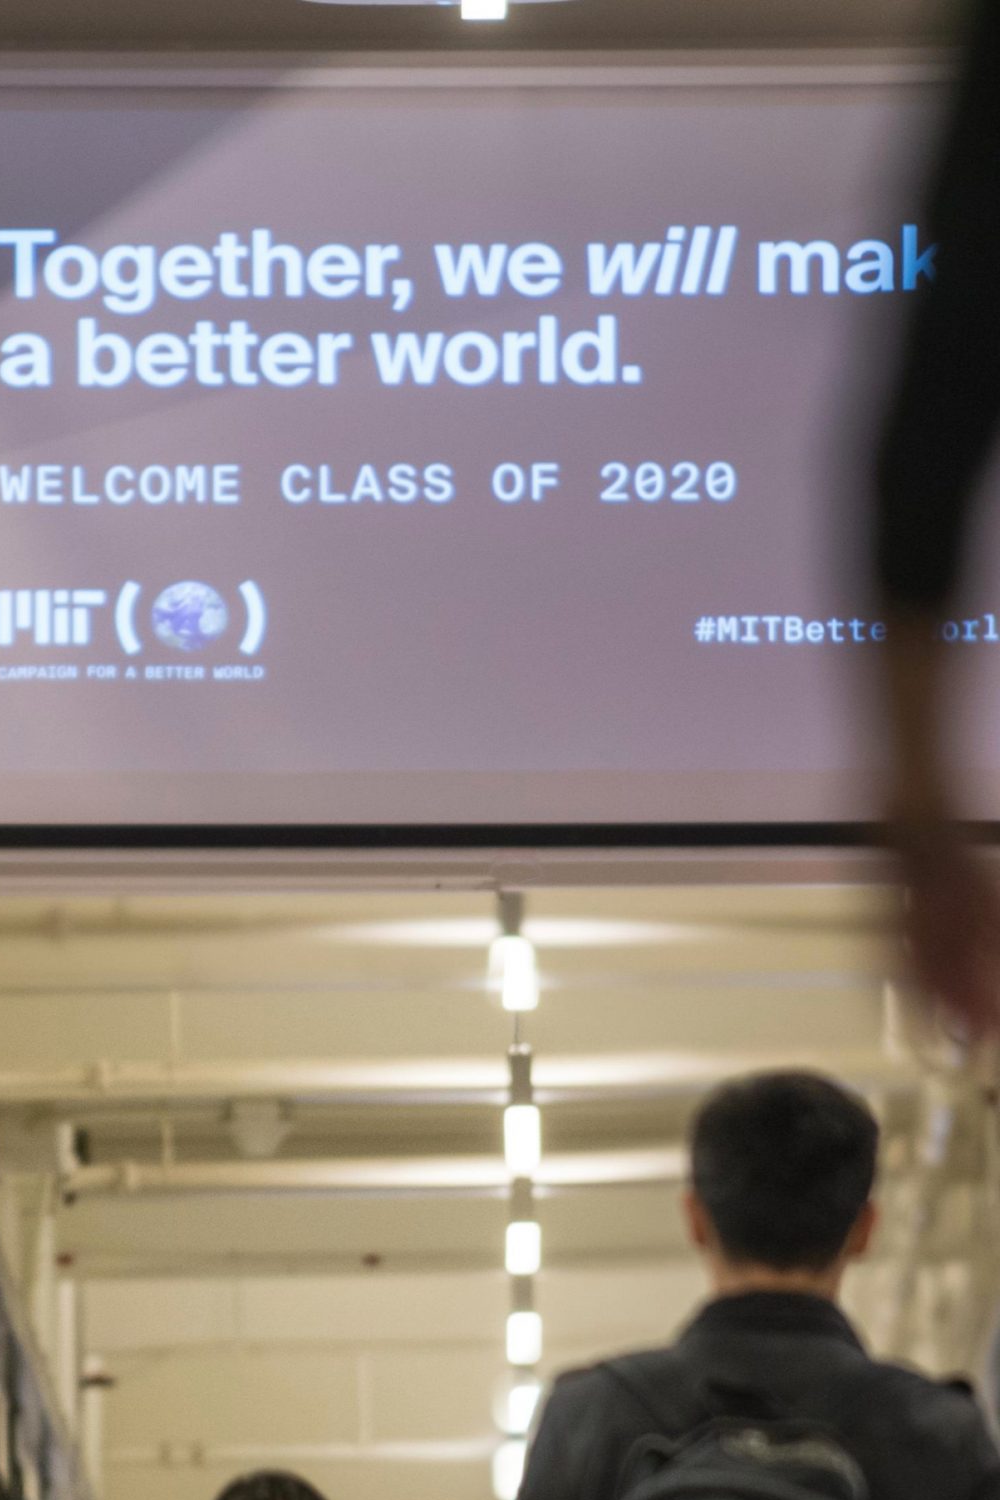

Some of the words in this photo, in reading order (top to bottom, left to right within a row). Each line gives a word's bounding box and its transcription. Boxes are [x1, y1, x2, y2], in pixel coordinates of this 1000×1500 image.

[433, 242, 563, 298] we
[586, 225, 738, 296] will
[757, 224, 939, 294] mak
[77, 319, 354, 388] better
[370, 317, 642, 386] world.
[280, 463, 455, 504] CLASS
[491, 462, 559, 503] OF
[600, 461, 737, 503] 2020
[86, 664, 118, 679] FOR
[124, 665, 137, 679] A
[144, 665, 206, 680] BETTER
[212, 665, 265, 680] WORLD
